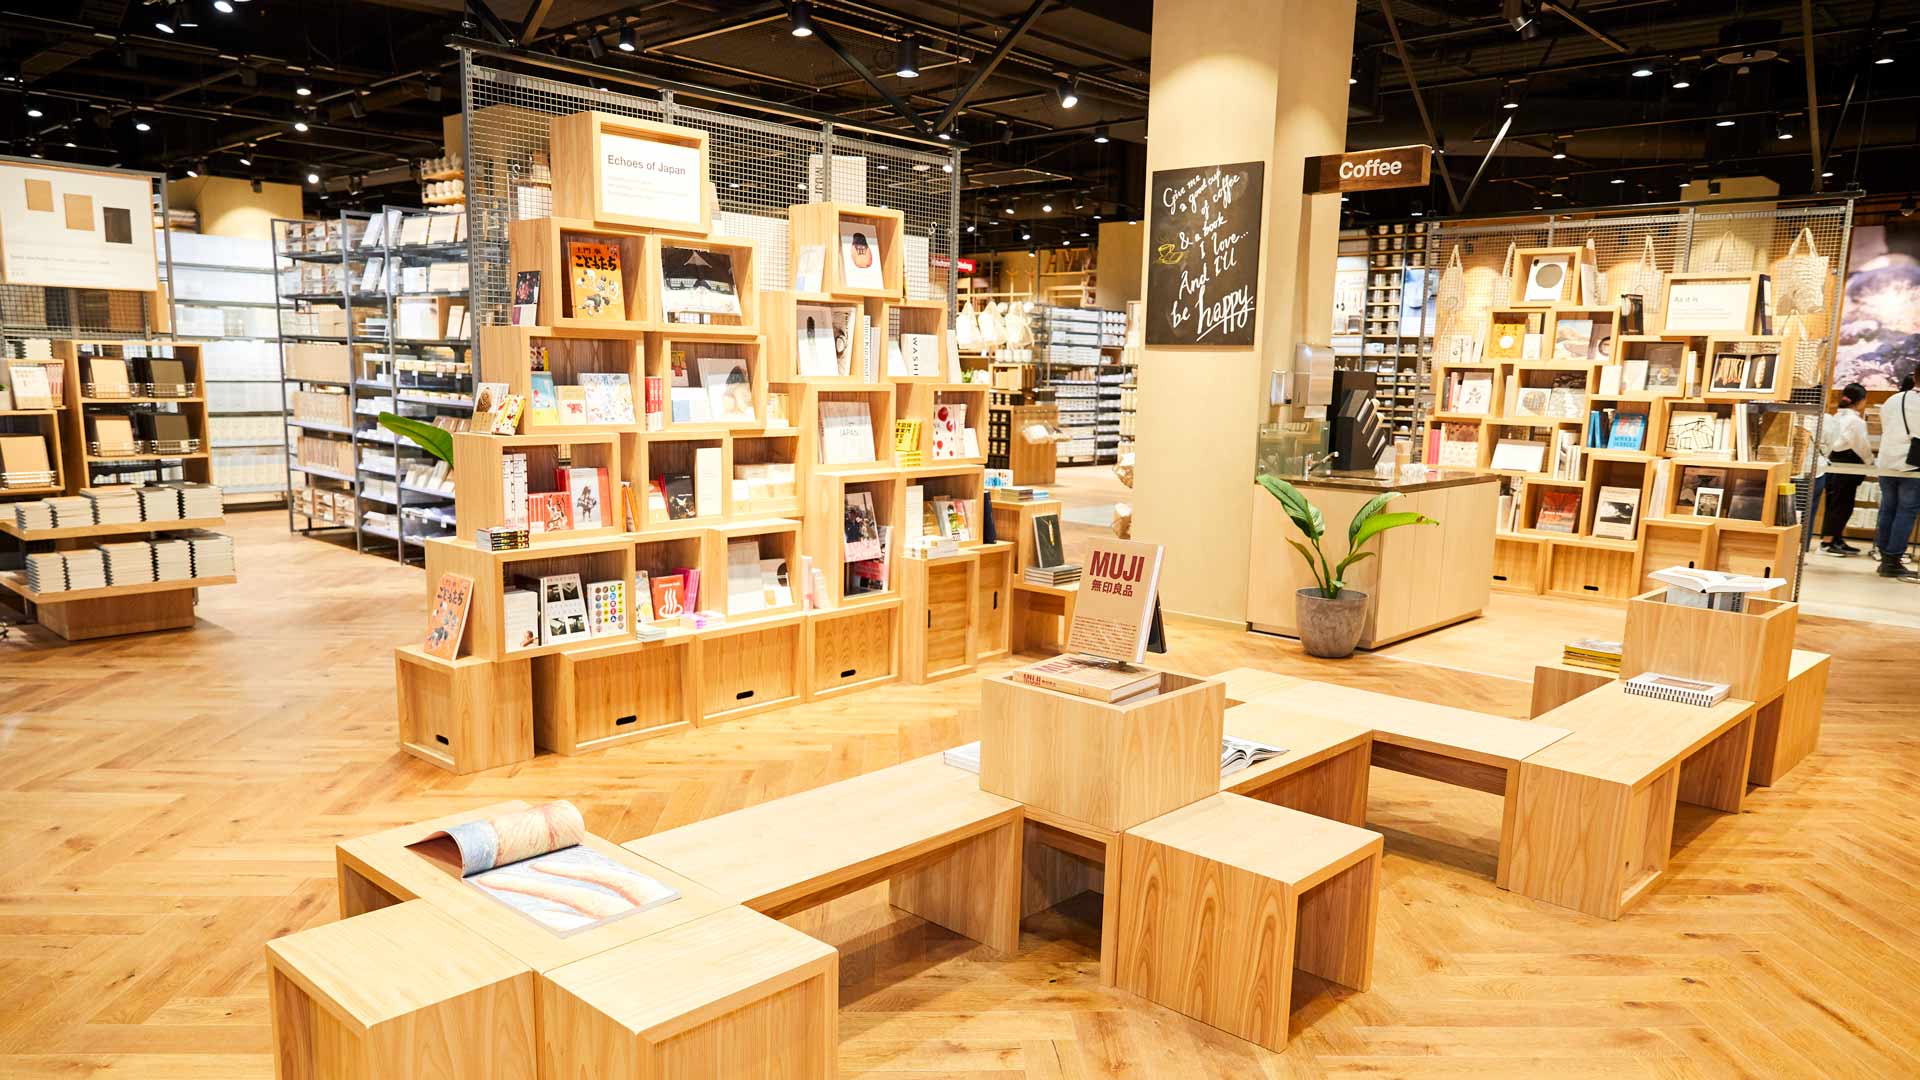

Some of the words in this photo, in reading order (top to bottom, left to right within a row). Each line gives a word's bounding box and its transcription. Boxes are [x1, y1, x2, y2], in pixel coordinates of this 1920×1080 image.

[607, 154, 644, 169] Echoes
[646, 161, 656, 171] of
[658, 162, 686, 175] Japan
[1339, 159, 1403, 179] Coffee
[1163, 187, 1186, 215] Give
[1187, 174, 1201, 189] me
[1188, 178, 1207, 213] good
[1208, 167, 1221, 188] cup
[1201, 199, 1210, 220] of
[1213, 174, 1241, 209] coffee
[1179, 232, 1194, 250] &
[1202, 211, 1228, 237] book
[575, 255, 617, 271] こどもたち
[1200, 241, 1206, 259] I
[1178, 262, 1210, 300] And
[1213, 247, 1238, 277] I'll
[1171, 300, 1191, 329] be
[1089, 550, 1145, 582] MUJI
[1090, 579, 1134, 598] 無印良品
